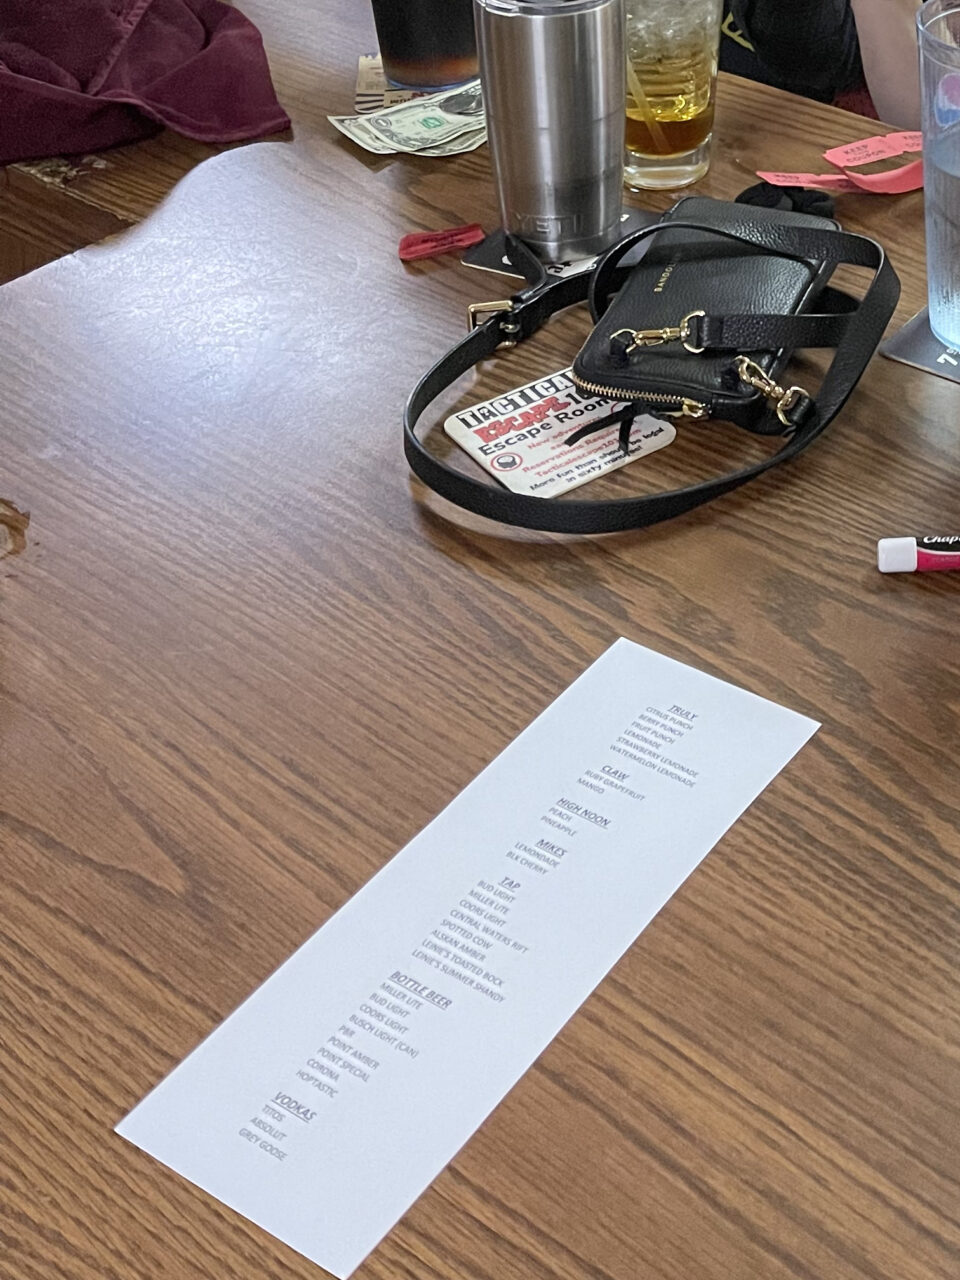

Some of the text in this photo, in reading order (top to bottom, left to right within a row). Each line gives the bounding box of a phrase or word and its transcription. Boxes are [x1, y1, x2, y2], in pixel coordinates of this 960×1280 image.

[937, 353, 958, 366] 7
[457, 370, 576, 429] TACTICA
[479, 422, 554, 457] Escape
[522, 427, 624, 473] Reservations Require
[529, 475, 555, 492] More
[557, 466, 574, 480] fun
[600, 446, 624, 461] shou
[642, 427, 664, 442] legal
[638, 714, 684, 737] BERRY PUNCH
[646, 706, 693, 730] CITRUS PUNCH
[669, 704, 699, 720] TRULY
[624, 729, 662, 750] LEMONADE
[631, 721, 675, 744] FRUIT PUNCH
[609, 744, 696, 788] WATERMELON LEMONADE
[616, 736, 699, 778] STRAWBERRY LEMONADE
[577, 777, 605, 794] MANGO
[584, 770, 646, 801] RUBY GRAPEFRUIT
[602, 765, 630, 781] CLAW
[540, 815, 578, 837] PINEAPPLE
[549, 807, 573, 822] PEACH
[557, 797, 611, 827] HIGH NOON
[537, 838, 568, 857] MIKES
[506, 851, 548, 875] BLK CHERRY
[477, 880, 516, 904] BUD LIGHT
[501, 877, 521, 890] TAP
[459, 899, 507, 927] COORS LIGHT
[468, 890, 511, 915] MILLER LITE
[432, 929, 486, 962] ALSKAN AMBER
[440, 919, 493, 950] SPOTTED COW
[450, 909, 529, 954] CENTRAL WATERS RIFT
[411, 949, 506, 1003] LEINIE'S SUMMER SHANDY
[422, 939, 505, 988] LEINIE'S TOASTED BOCK
[380, 982, 424, 1011] MILLER LITE
[390, 971, 452, 1009] BOTTLE BEER
[359, 1004, 409, 1035] COORS LIGHT
[369, 993, 411, 1018] BUD LIGHT
[338, 1025, 356, 1037] PBR
[349, 1014, 419, 1059] BUSCH LIGHT (CAN)
[317, 1047, 371, 1082] POINT SPECIAL
[328, 1036, 380, 1070] POINT AMBER
[296, 1070, 339, 1098] HOPTASTIC
[306, 1059, 341, 1082] CORONA
[262, 1105, 286, 1122] TITOS
[273, 1092, 317, 1122] VODKAS
[250, 1117, 287, 1141] ABSOLUT
[238, 1127, 288, 1161] GREY GOOSE
